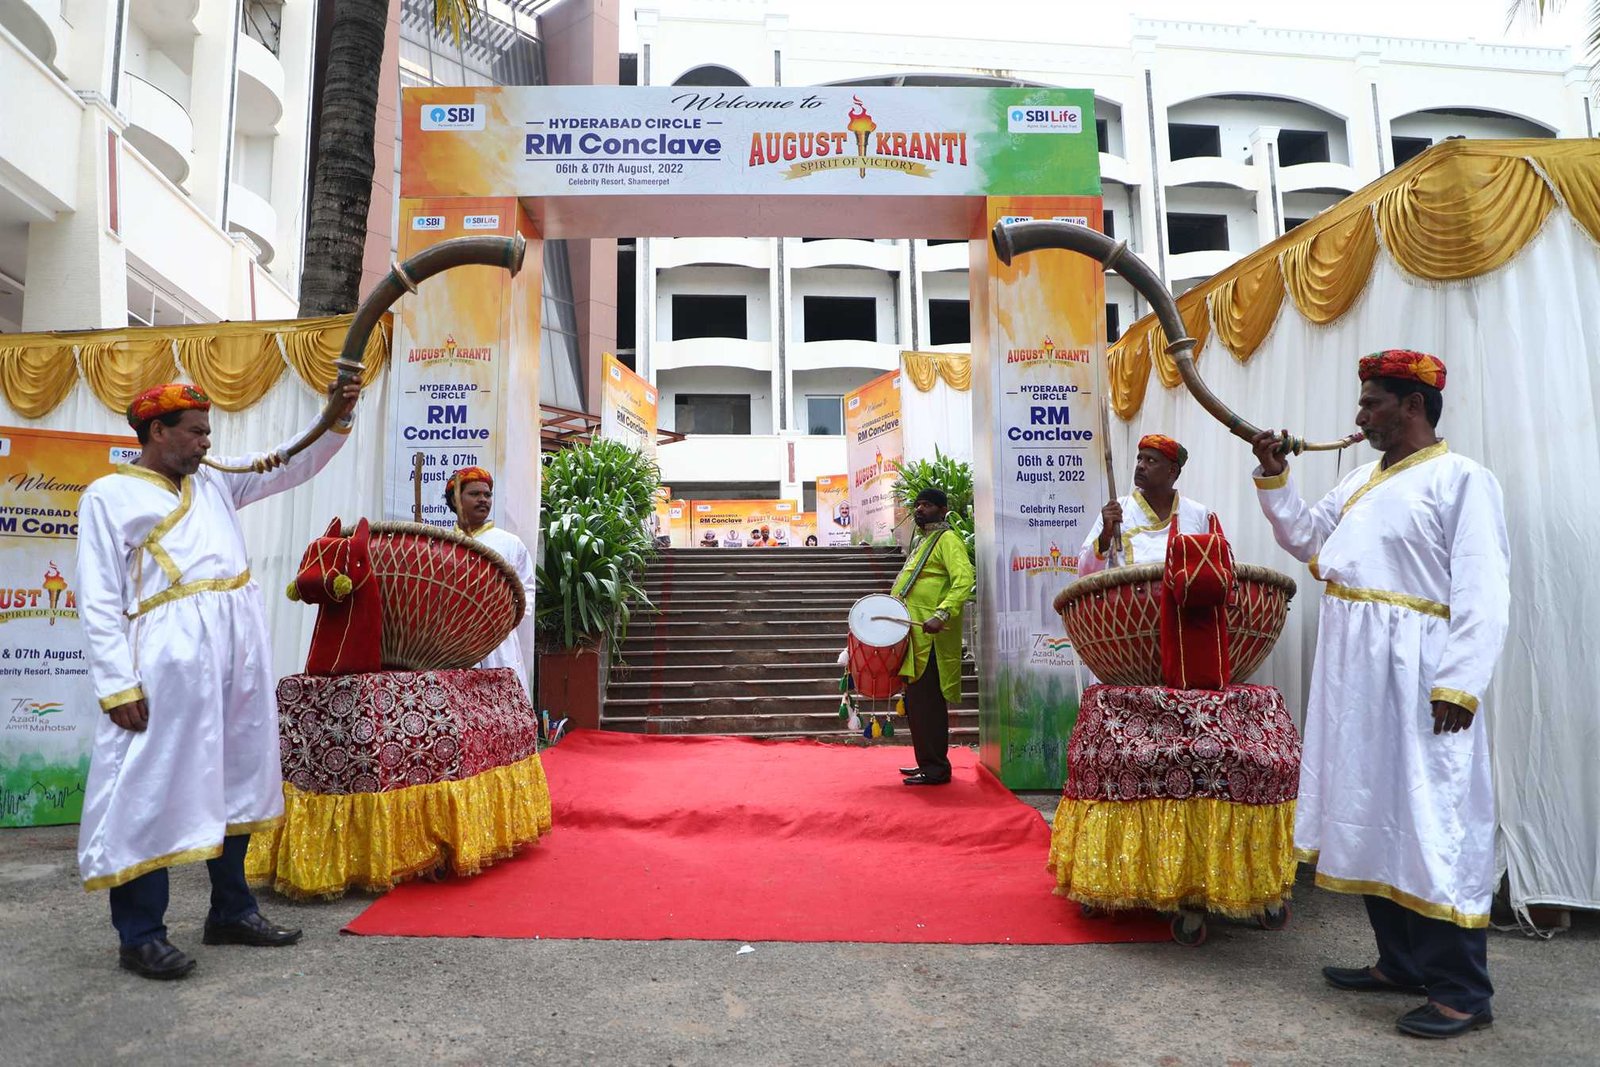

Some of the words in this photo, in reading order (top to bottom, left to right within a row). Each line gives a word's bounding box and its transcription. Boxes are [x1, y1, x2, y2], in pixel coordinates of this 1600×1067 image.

[671, 92, 795, 112] Welcome
[800, 93, 826, 110] to
[447, 107, 475, 122] SBI
[1026, 110, 1048, 122] SBI
[1051, 110, 1077, 122] Life
[549, 118, 642, 130] HYDERABAD
[645, 118, 702, 130] CIRCLE
[525, 134, 572, 155] RM
[578, 132, 722, 155] Conclave
[748, 132, 847, 166] AUGUST
[876, 132, 968, 166] KRANTI
[556, 163, 578, 174] 06th
[581, 164, 590, 174] &
[592, 163, 616, 174] 07th
[618, 163, 656, 177] August,
[658, 163, 684, 174] 2022
[800, 160, 840, 172] SPIRIT
[842, 158, 858, 167] OF
[860, 157, 916, 171] VICTORY
[568, 178, 598, 188] Celebrity
[601, 178, 625, 187] Resort,
[628, 177, 670, 188] Shameerpet
[426, 218, 440, 226] SBI
[408, 348, 446, 363] AUGUST
[456, 348, 491, 362] KRANTI
[1008, 350, 1044, 363] AUGUST
[1055, 349, 1089, 363] KRANTI
[428, 406, 467, 424] RM
[1030, 406, 1069, 424] RM
[617, 410, 625, 424] RM
[626, 416, 648, 437] Conclave
[858, 430, 867, 442] RM
[868, 419, 899, 437] Conclave
[404, 426, 490, 440] Conclave
[1008, 427, 1093, 441] Conclave
[440, 454, 448, 466] &
[453, 454, 477, 466] 07th
[1017, 455, 1042, 466] 06th
[1046, 455, 1054, 466] &
[1058, 455, 1083, 466] 07th
[8, 473, 88, 492] Welcome
[856, 464, 877, 488] AUGUST
[1016, 470, 1056, 484] August,
[1059, 470, 1085, 482] 2022
[0, 506, 71, 517] HYDERABAD
[1020, 504, 1056, 515] Celebrity
[1058, 504, 1084, 513] Resort
[1028, 518, 1077, 528] Shameerpet
[1012, 556, 1050, 571] AUGUST
[0, 610, 34, 619] SPIRIT
[2, 649, 10, 659] &
[15, 649, 40, 659] 07th
[44, 649, 85, 661] August,
